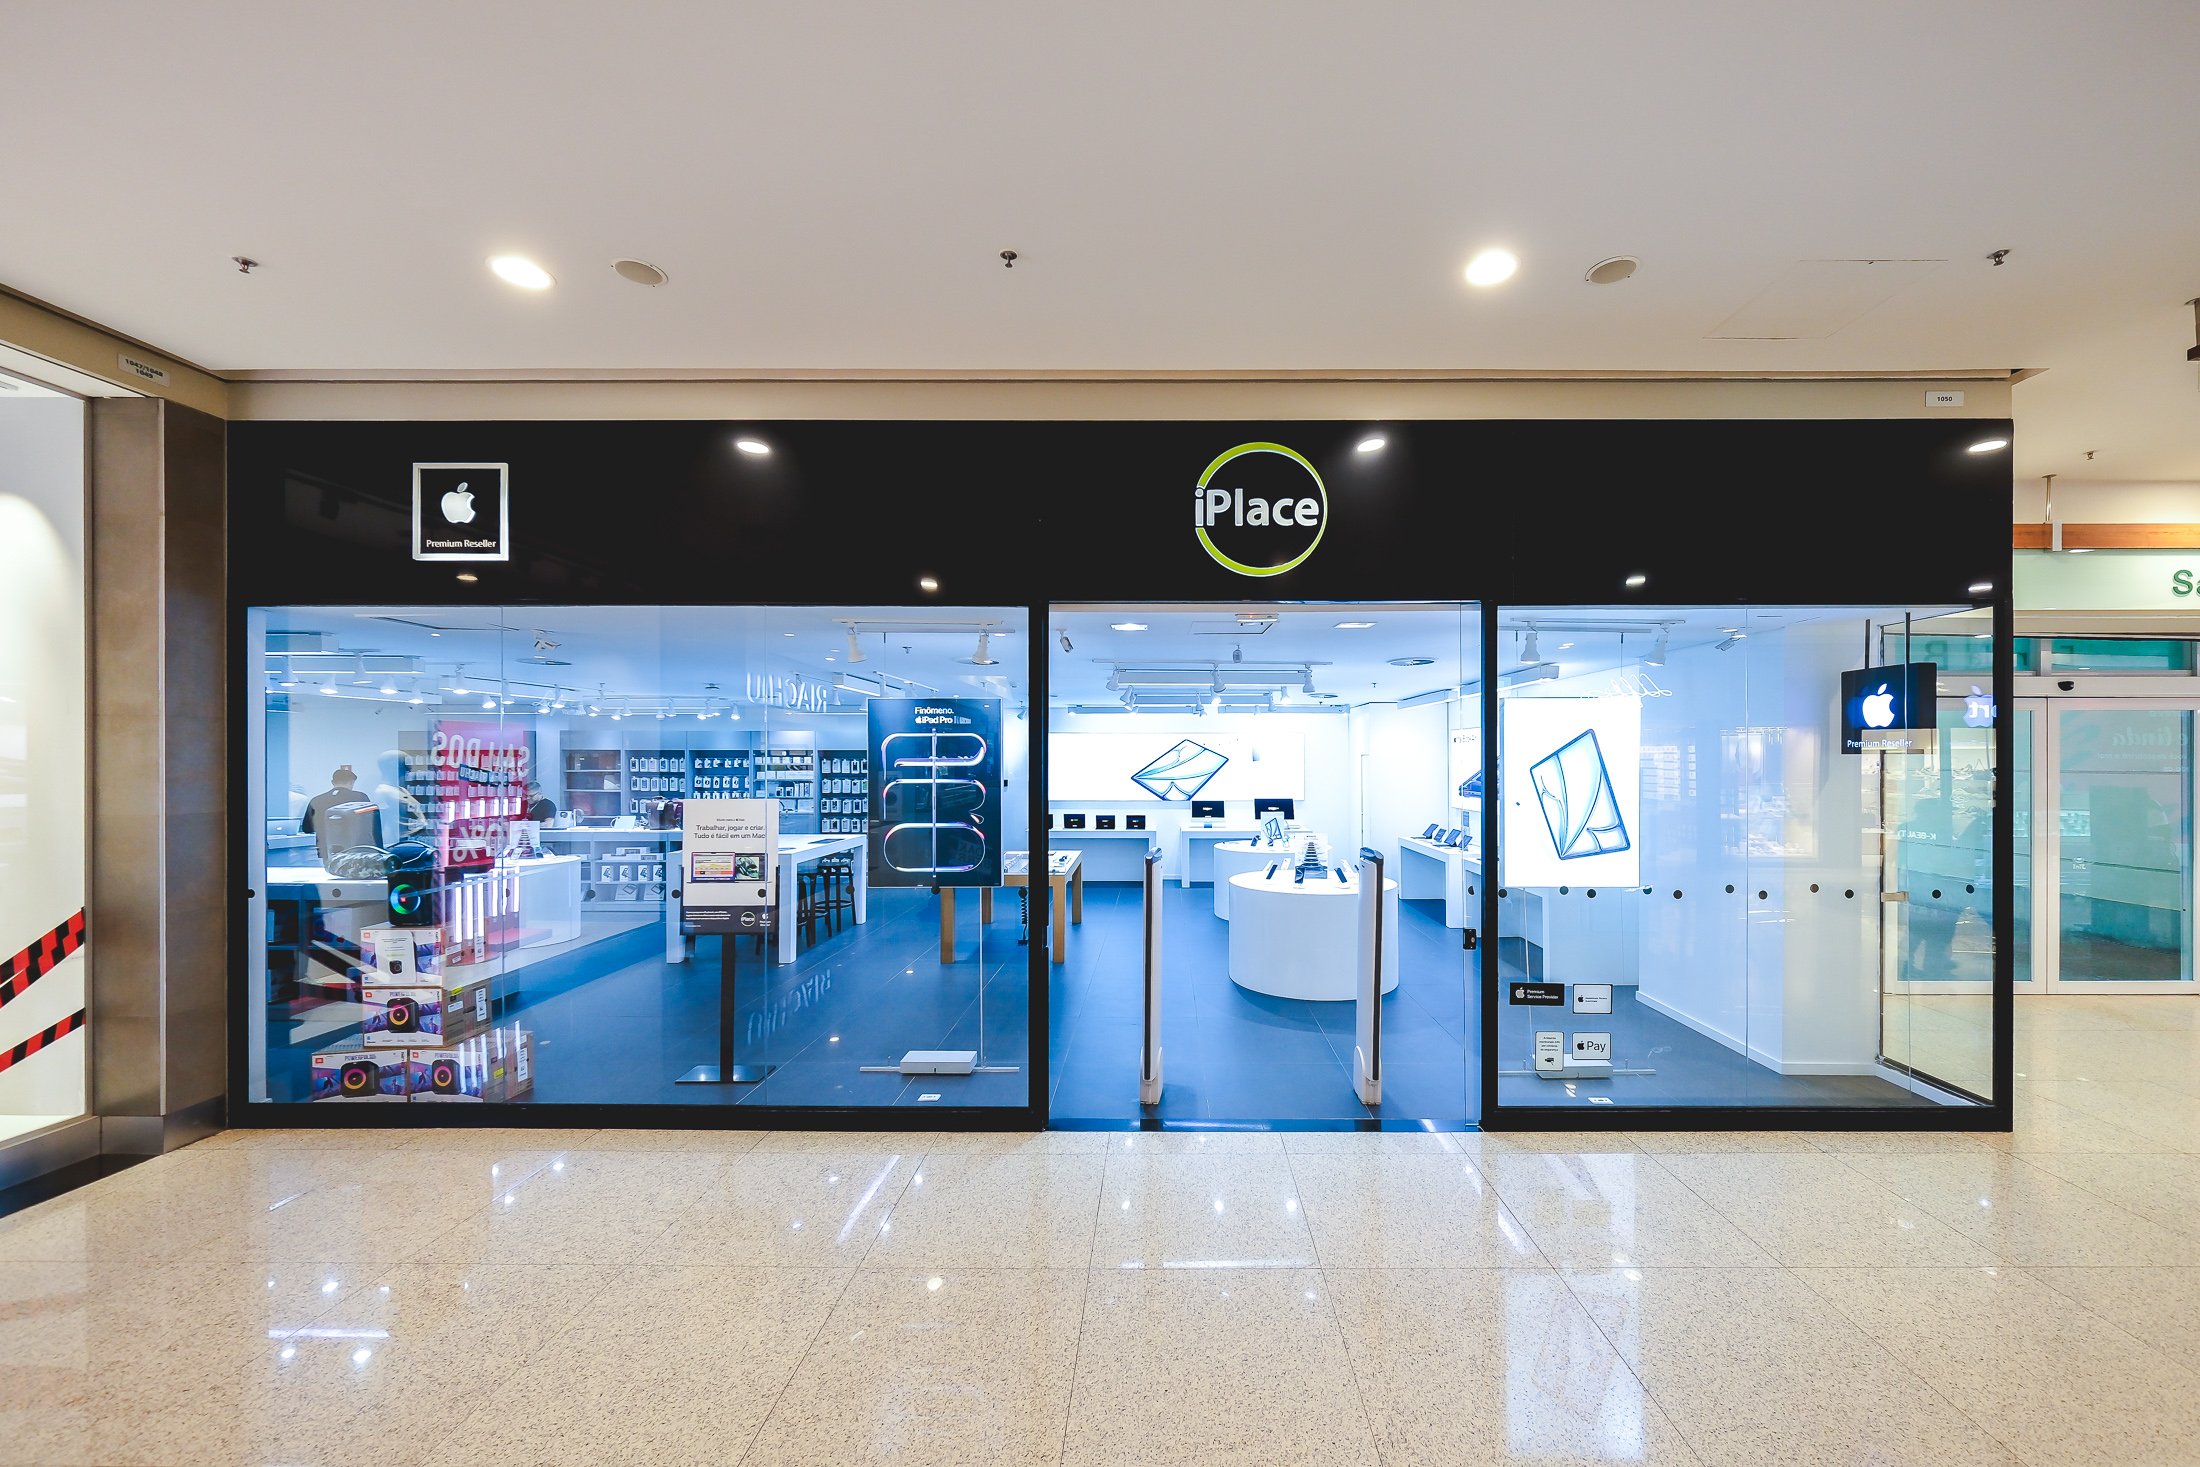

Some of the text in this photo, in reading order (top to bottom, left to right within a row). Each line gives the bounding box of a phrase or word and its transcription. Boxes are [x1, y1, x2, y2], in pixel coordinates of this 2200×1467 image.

[1194, 488, 1320, 527] iPlace
[426, 539, 497, 548] Premium Reseller
[940, 715, 954, 724] Pro
[1847, 739, 1913, 748] Premium Reseller
[1586, 1040, 1607, 1053] Pay
